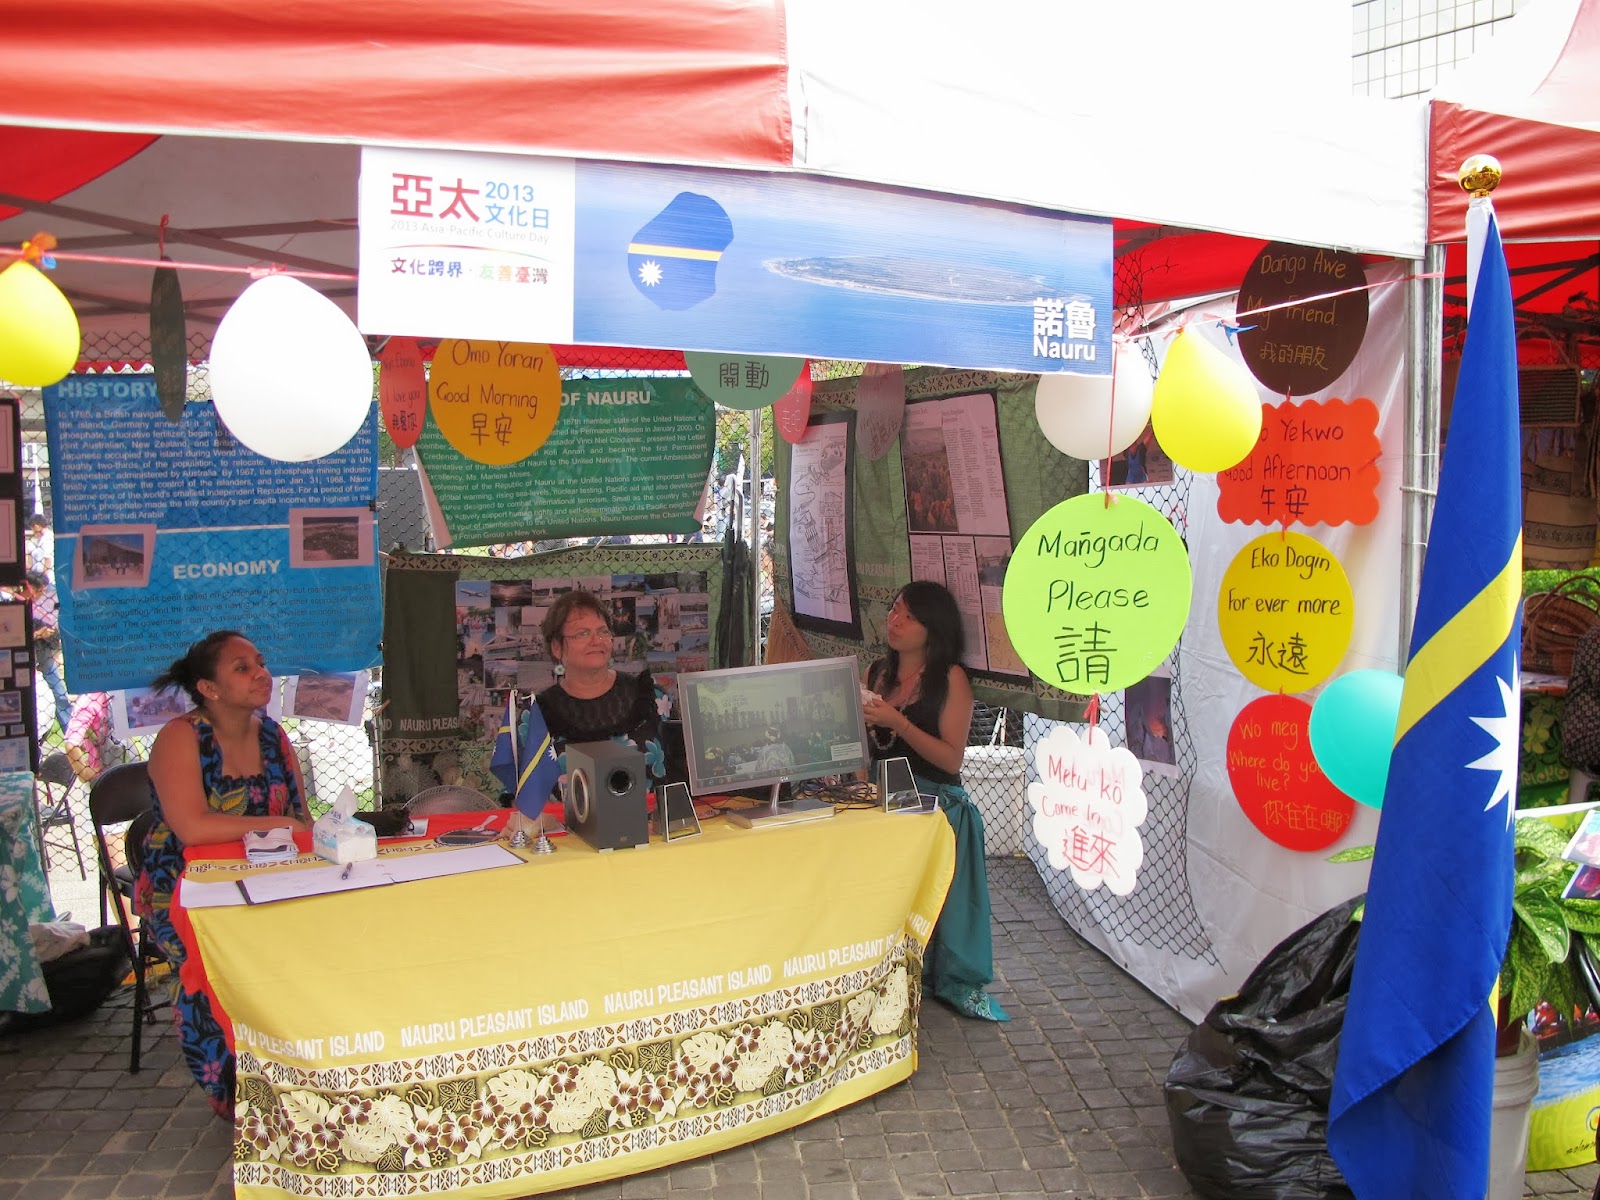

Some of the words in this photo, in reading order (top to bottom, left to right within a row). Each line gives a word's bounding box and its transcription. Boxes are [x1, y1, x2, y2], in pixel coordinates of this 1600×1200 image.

[390, 172, 480, 223] 亞太
[485, 181, 534, 203] 2013
[485, 203, 549, 230] 文化日
[391, 219, 418, 232] 2013
[487, 228, 526, 241] Culture
[529, 232, 549, 245] Day
[391, 257, 463, 279] 文化跨界
[1032, 297, 1096, 341] 諾魯
[1246, 295, 1271, 331] My
[452, 339, 490, 366] Omo
[497, 341, 544, 373] Yoran
[1032, 336, 1096, 361] Nauru
[1260, 341, 1328, 370] 我的朋友
[720, 361, 769, 390] 開動
[58, 381, 158, 399] HISTORY
[436, 381, 470, 404] Good
[480, 383, 538, 420] Morning
[560, 392, 581, 407] OF
[587, 390, 651, 406] NAURU
[111, 420, 150, 432] Germany
[653, 414, 672, 422] United
[674, 413, 697, 421] Nations
[116, 430, 151, 440] lucrative
[470, 412, 512, 446] 早安
[1280, 418, 1344, 443] Yekwo
[61, 451, 102, 462] Japanese
[105, 450, 142, 461] occupied
[144, 450, 157, 459] the
[186, 447, 211, 458] during
[132, 439, 150, 449] New
[194, 438, 209, 447] and
[62, 462, 93, 473] roughly
[97, 460, 139, 471] two-thirds
[155, 459, 168, 468] the
[317, 456, 347, 465] became
[360, 455, 372, 464] UN
[571, 455, 593, 466] United
[1263, 453, 1351, 481] Afternoon
[63, 481, 88, 492] finally
[92, 481, 109, 490] was
[112, 480, 136, 490] under
[140, 479, 153, 489] the
[157, 479, 185, 489] control
[199, 478, 213, 487] the
[257, 476, 272, 485] and
[349, 473, 372, 482] Nauru
[116, 470, 168, 480] administered
[170, 469, 181, 480] by
[221, 468, 232, 478] By
[259, 467, 272, 476] the
[274, 466, 313, 477] phosphate
[316, 465, 341, 475] mining
[343, 464, 372, 475] industry
[580, 476, 603, 486] United
[604, 474, 631, 484] Nations
[63, 491, 97, 501] became
[143, 488, 170, 499] world's
[172, 487, 205, 498] smallest
[298, 484, 312, 494] For
[320, 483, 344, 496] period
[65, 502, 97, 512] Nauru's
[99, 500, 142, 512] phosphate
[144, 499, 167, 509] made
[169, 499, 183, 509] the
[185, 499, 199, 510] tiny
[201, 497, 236, 509] country's
[239, 498, 251, 507] per
[253, 495, 277, 506] capita
[279, 495, 306, 505] income
[322, 493, 349, 504] highest
[1260, 484, 1309, 518] 午安
[92, 511, 111, 520] after
[113, 509, 137, 520] Saudi
[459, 531, 482, 541] Forum
[483, 530, 505, 541] Group
[173, 559, 281, 580] ECONOMY
[1251, 546, 1279, 569] Eko
[1286, 545, 1330, 580] Dogin
[1046, 579, 1150, 613] Please
[1297, 598, 1341, 616] more
[1054, 620, 1118, 684] 請
[1245, 630, 1310, 675] 永遠
[400, 718, 432, 732] NAURU
[432, 716, 459, 730] PLEAS
[1239, 718, 1262, 740] Wo
[1229, 749, 1267, 768] Where
[1272, 752, 1290, 771] do
[1042, 795, 1079, 818] Come
[1061, 824, 1120, 879] 進來
[257, 1031, 324, 1061] PLEASANT
[329, 1030, 385, 1058] ISLAND
[401, 1020, 456, 1048] NAURU
[460, 1008, 533, 1039] PLEASANT
[538, 998, 589, 1028] ISLAND
[604, 987, 654, 1015] NAURU
[658, 974, 723, 1004] PLEASANT
[727, 964, 772, 991] ISLAND
[783, 952, 826, 979] NAURU
[829, 939, 884, 968] PLEASANT
